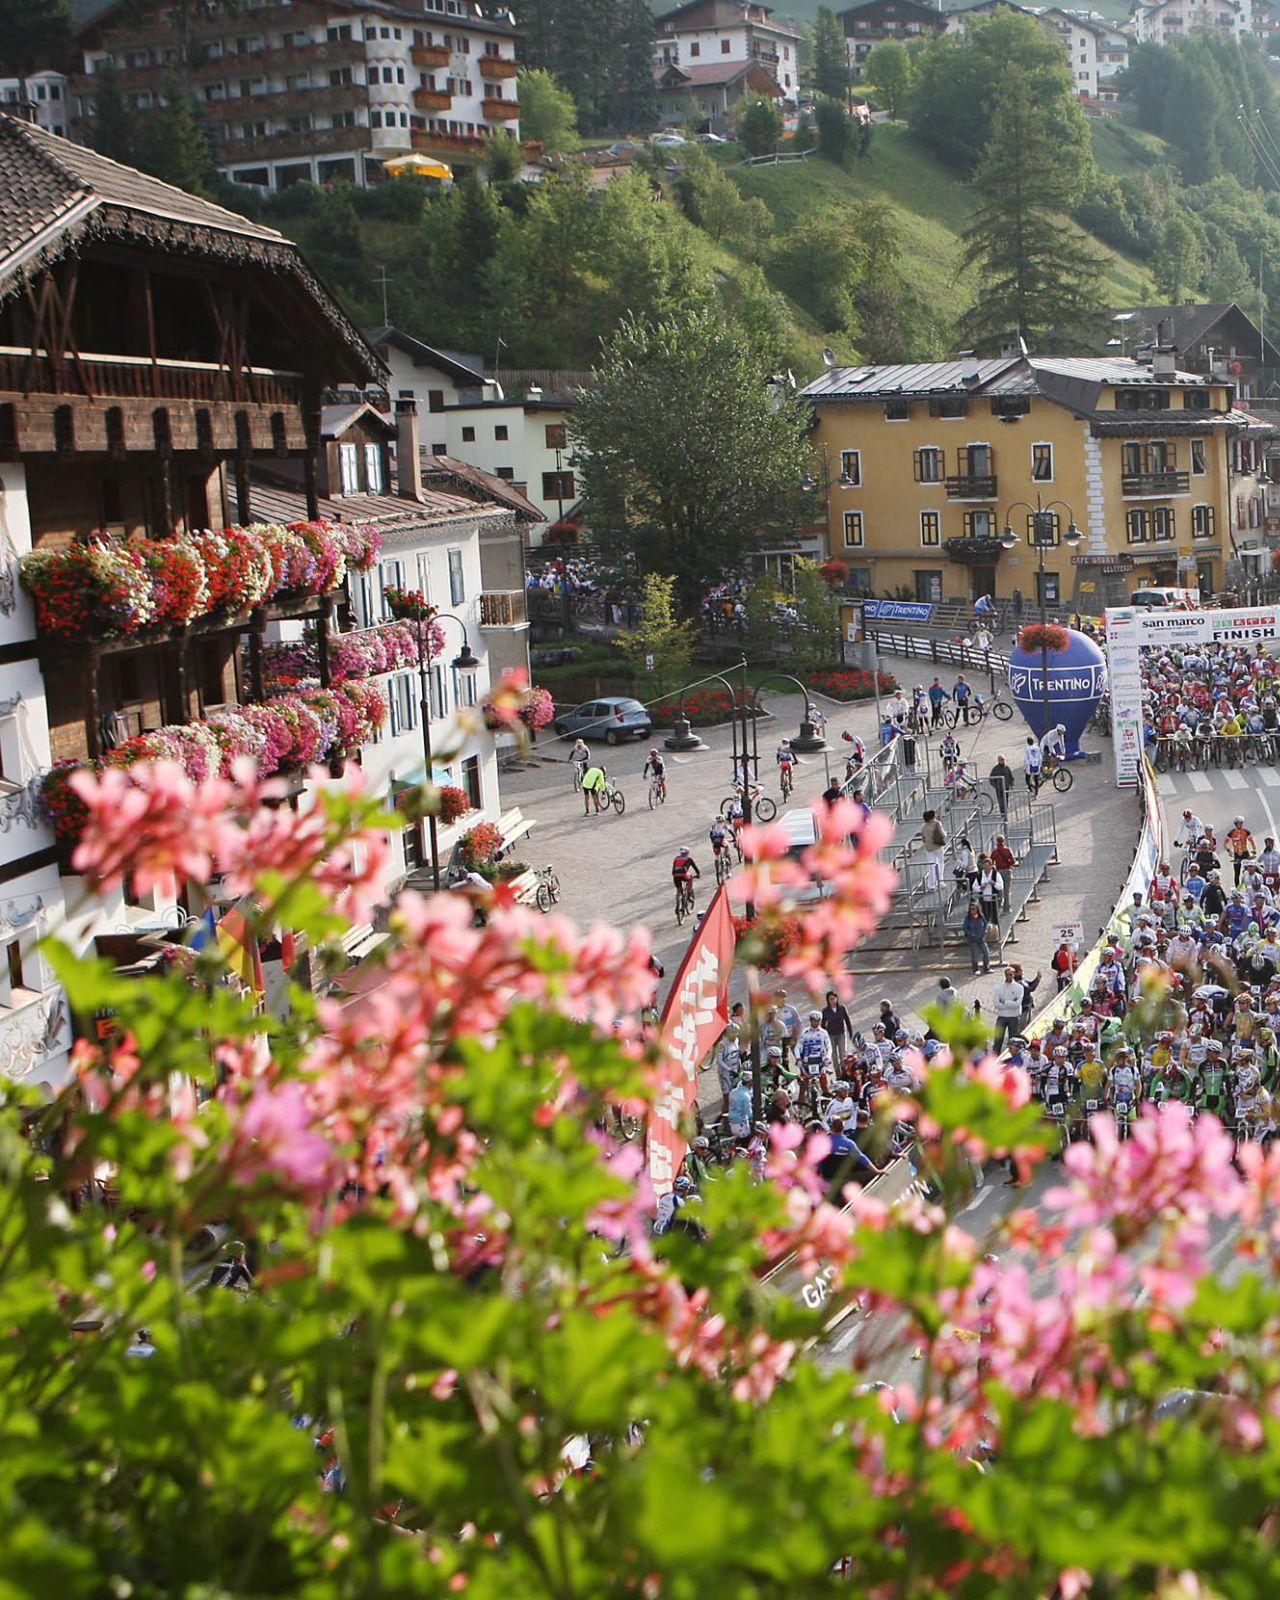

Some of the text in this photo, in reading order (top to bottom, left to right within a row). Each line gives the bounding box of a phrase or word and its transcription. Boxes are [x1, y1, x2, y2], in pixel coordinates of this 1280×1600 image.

[894, 604, 929, 616] TRENTINO
[1142, 619, 1164, 628] san
[1167, 617, 1205, 627] marco
[1213, 628, 1275, 641] FINISH
[1032, 677, 1090, 691] TRENTINO
[1060, 929, 1074, 938] 25
